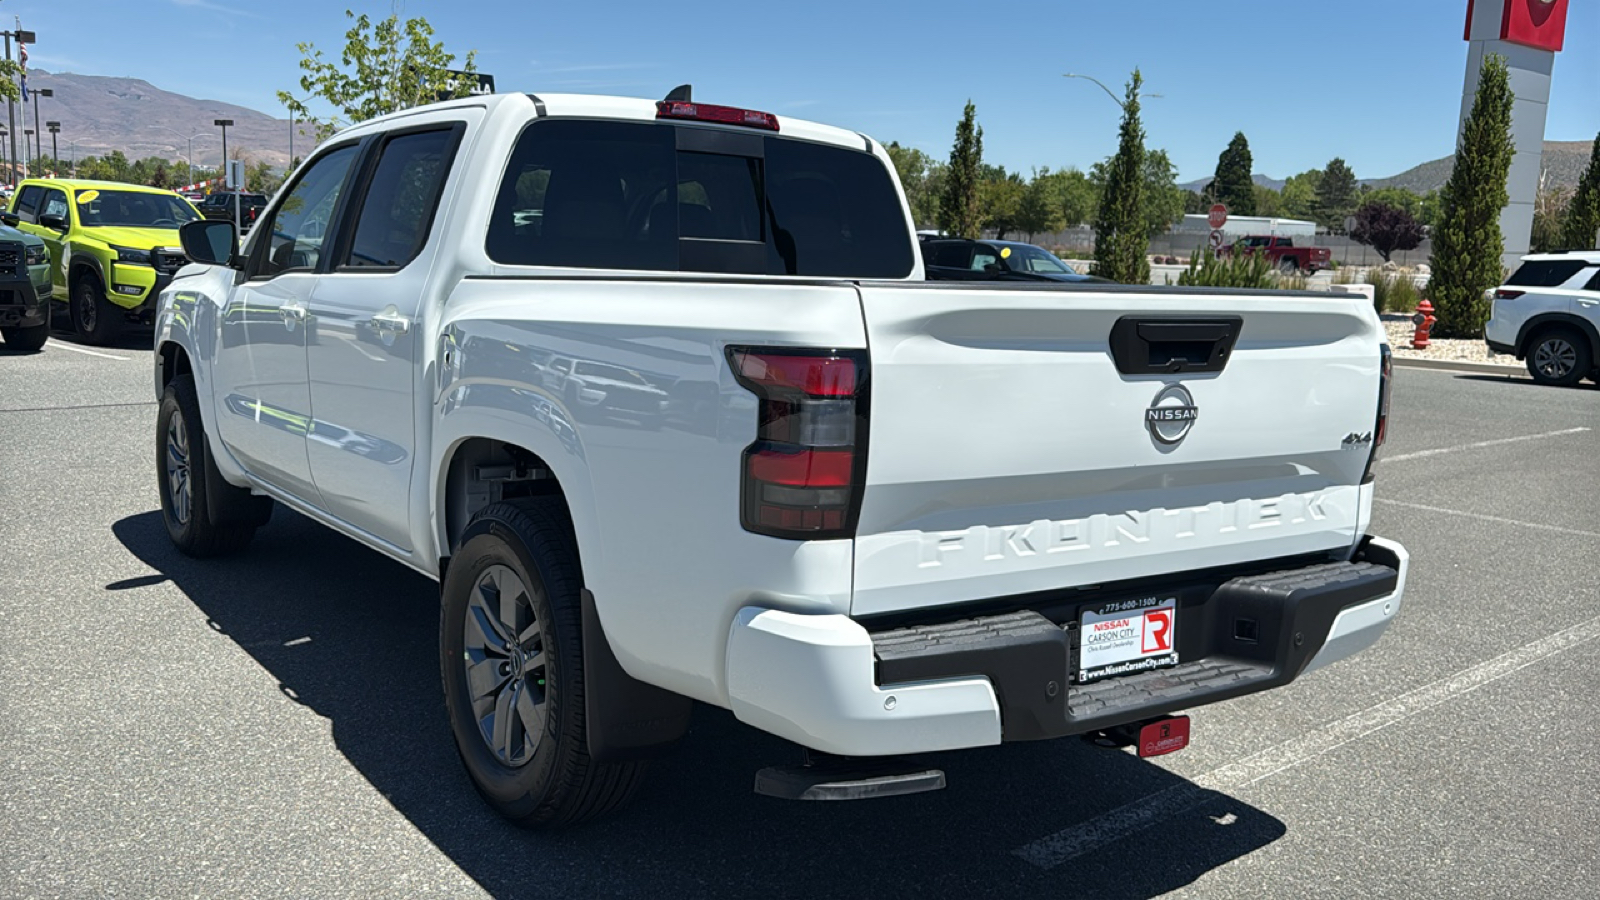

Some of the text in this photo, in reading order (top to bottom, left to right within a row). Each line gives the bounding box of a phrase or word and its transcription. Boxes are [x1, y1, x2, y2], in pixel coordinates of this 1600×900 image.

[1148, 409, 1197, 420] NISSAN
[916, 491, 1328, 568] FRONTIER
[1105, 597, 1157, 612] 775-600-1500
[1093, 619, 1130, 632] NISSAN
[1088, 628, 1135, 644] CARSON CITY
[1088, 657, 1171, 680] www.NissanCarsonCity.com
[545, 633, 558, 740] MICHELIN
